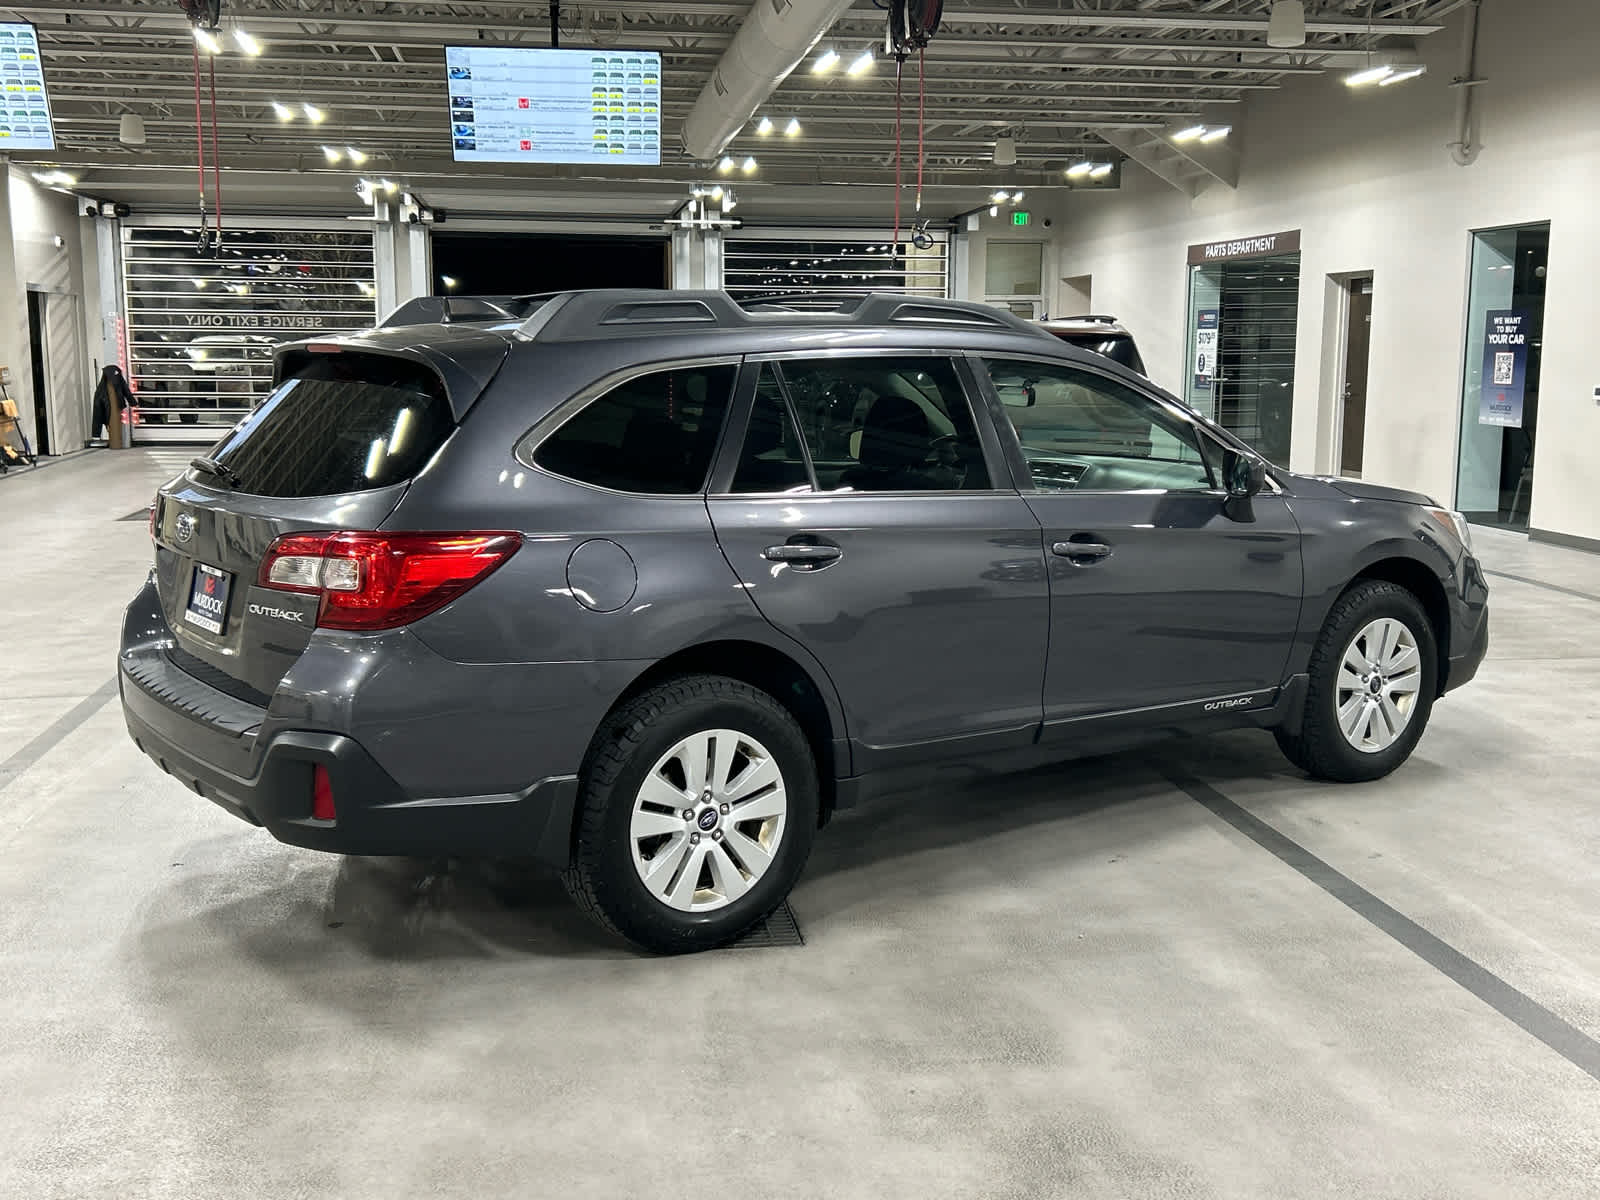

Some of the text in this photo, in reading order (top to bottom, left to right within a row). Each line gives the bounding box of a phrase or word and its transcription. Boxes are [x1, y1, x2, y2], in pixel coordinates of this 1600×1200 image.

[1205, 237, 1276, 257] PARTS DEPARTMENT
[1494, 316, 1522, 325] WE WANT
[1488, 334, 1525, 344] YOUR CAR
[194, 591, 224, 615] MURDOCK
[248, 604, 304, 622] OUTBACK
[1204, 697, 1253, 710] OUTBACK
